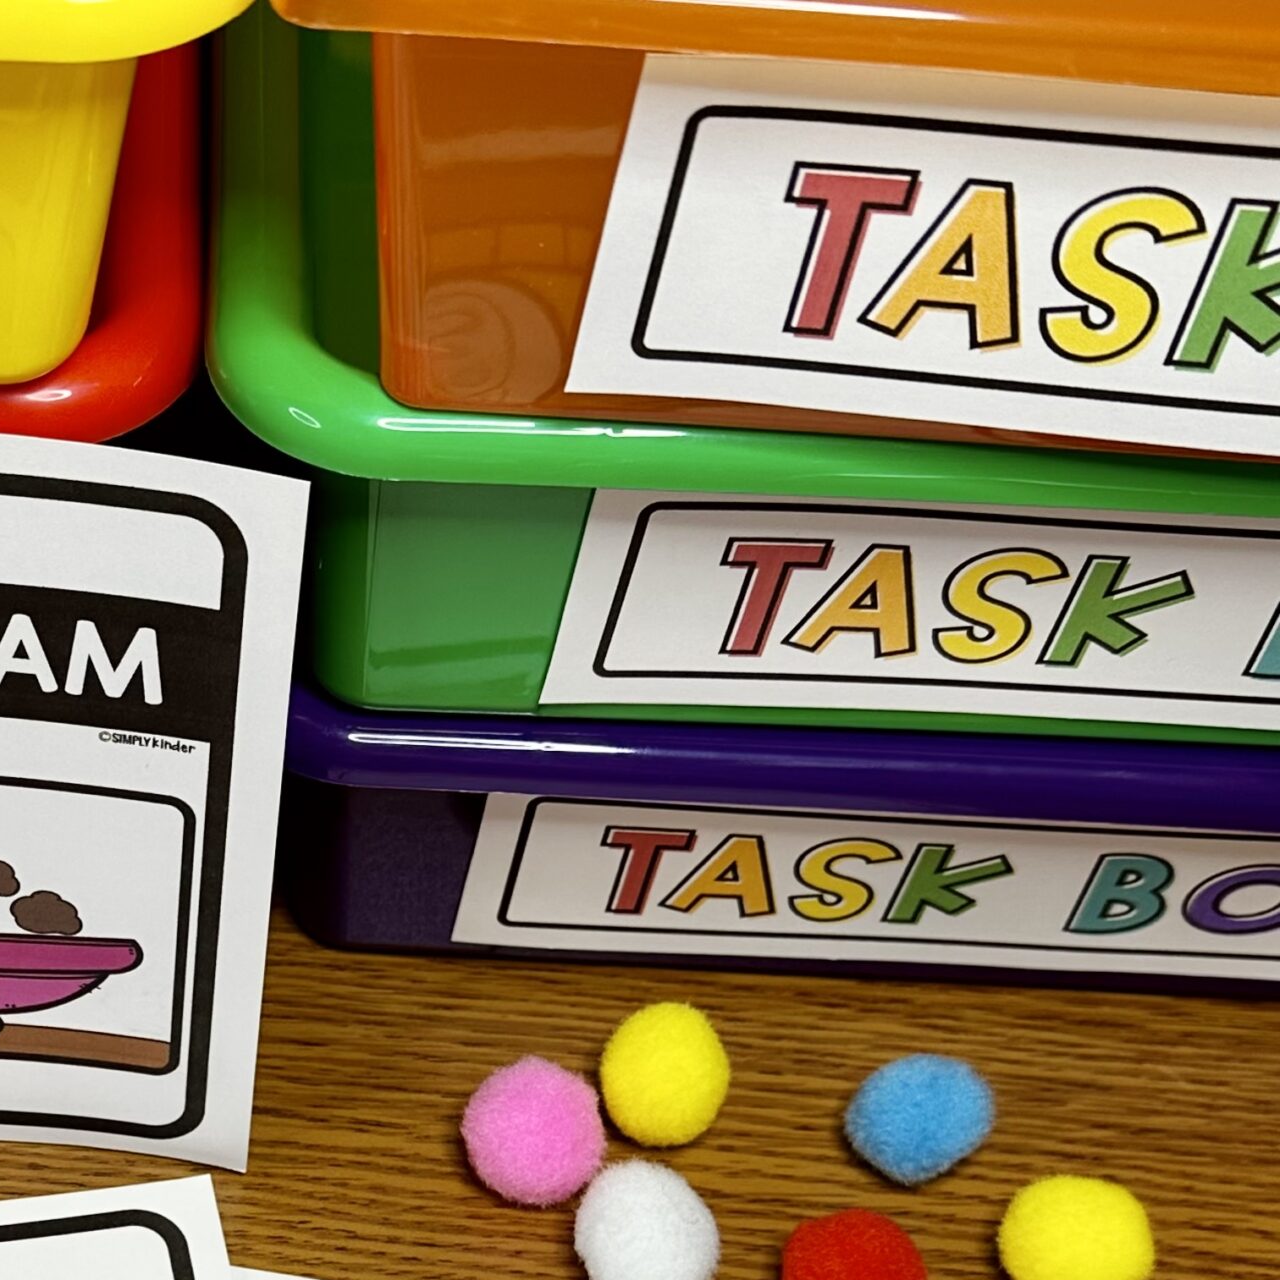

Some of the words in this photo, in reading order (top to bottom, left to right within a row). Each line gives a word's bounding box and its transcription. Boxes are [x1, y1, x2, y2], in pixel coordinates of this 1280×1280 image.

[783, 161, 1280, 374] TASK
[720, 537, 1196, 669] TASK
[601, 825, 1015, 924] TASK
